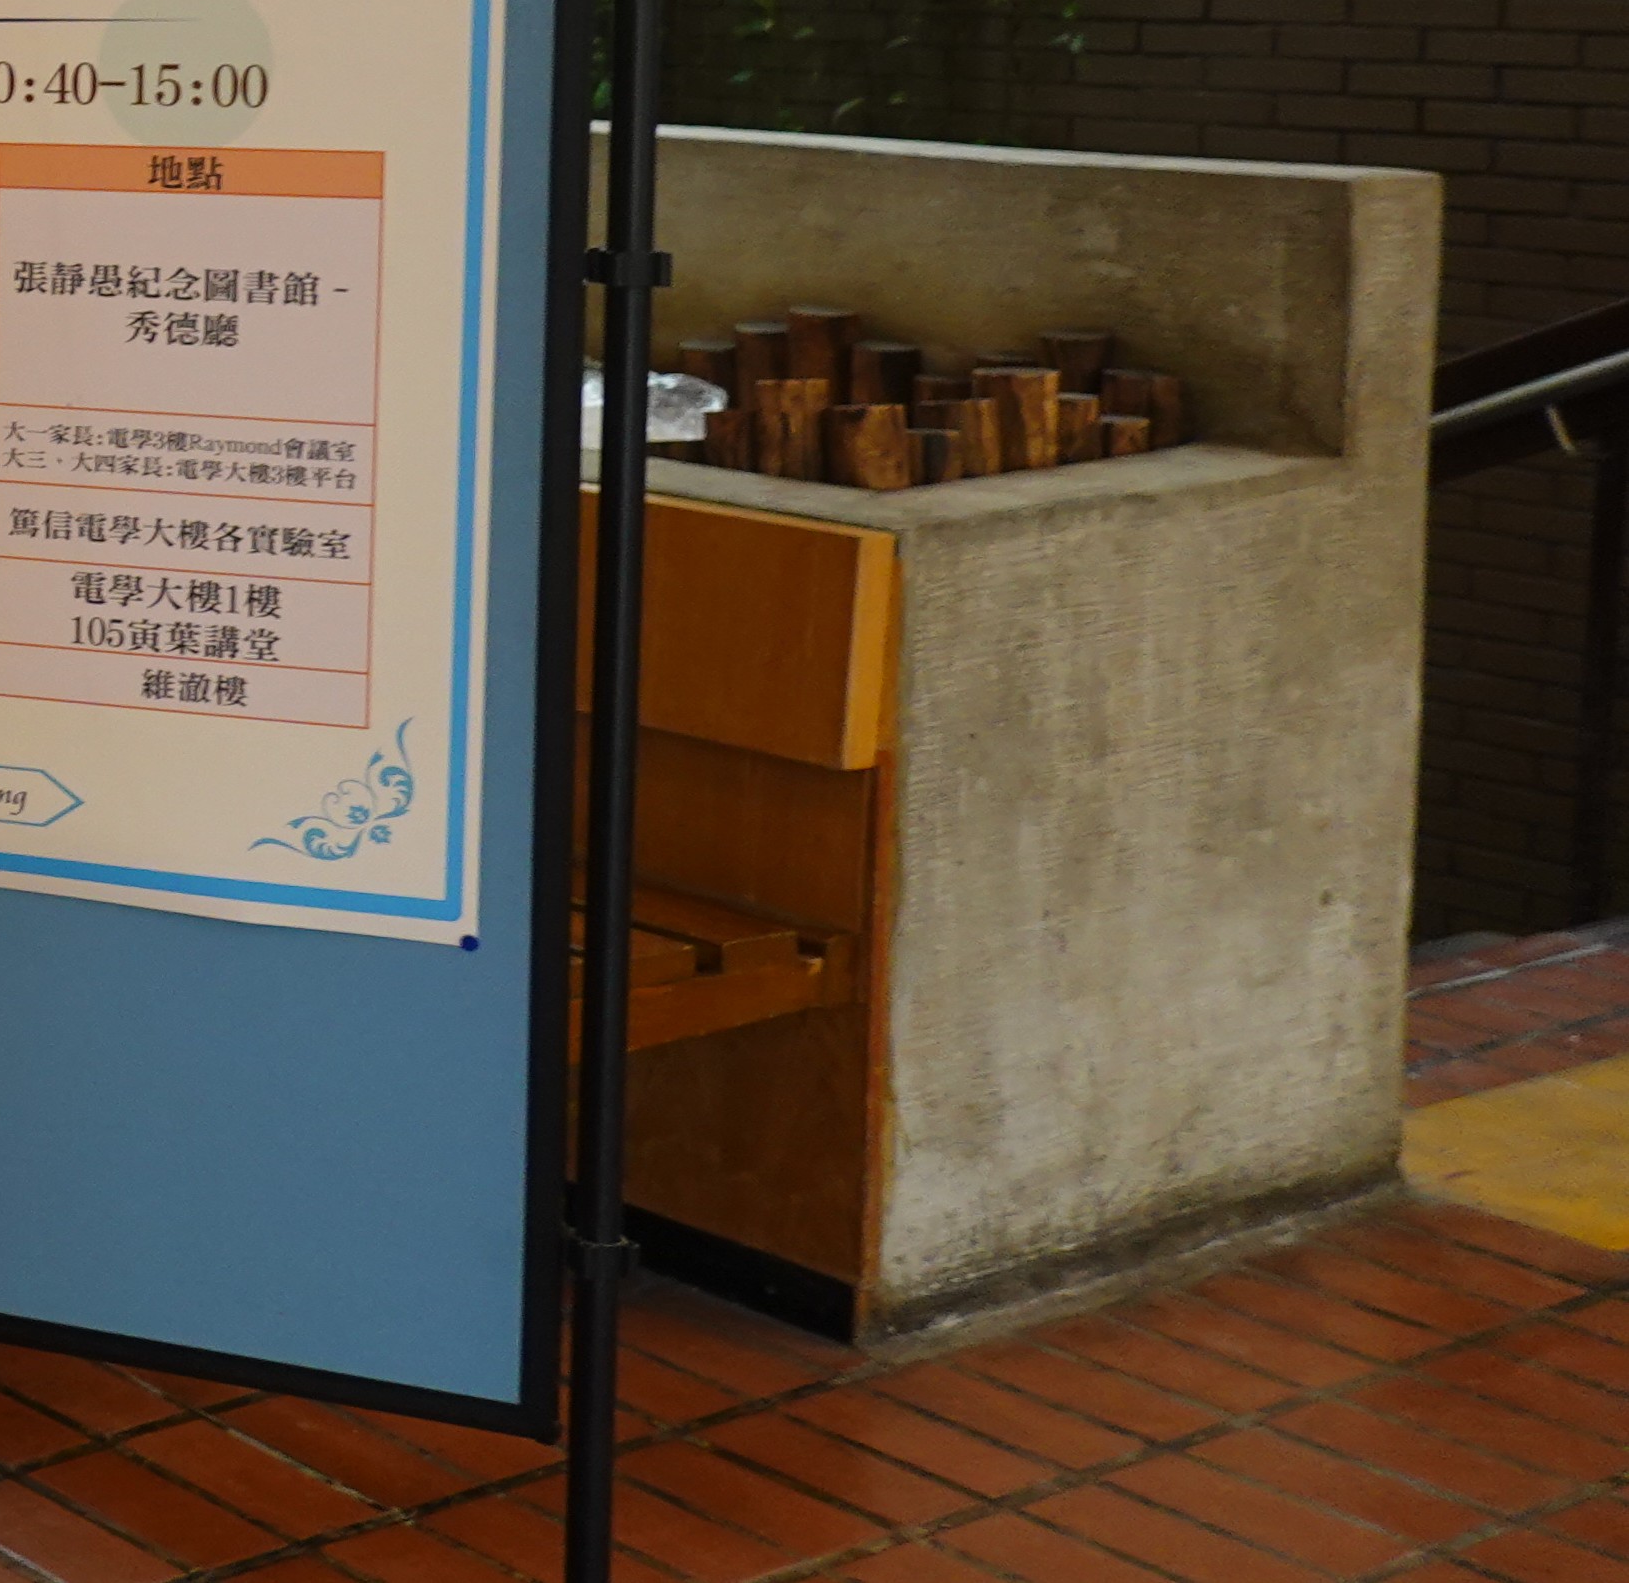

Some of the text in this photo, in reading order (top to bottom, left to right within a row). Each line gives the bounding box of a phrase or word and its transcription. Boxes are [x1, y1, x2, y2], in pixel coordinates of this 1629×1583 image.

[147, 154, 225, 192] 地點
[123, 308, 243, 349] 秀德廳
[70, 570, 283, 620] 電學大樓1樓
[70, 614, 281, 663] 105寅葉講堂
